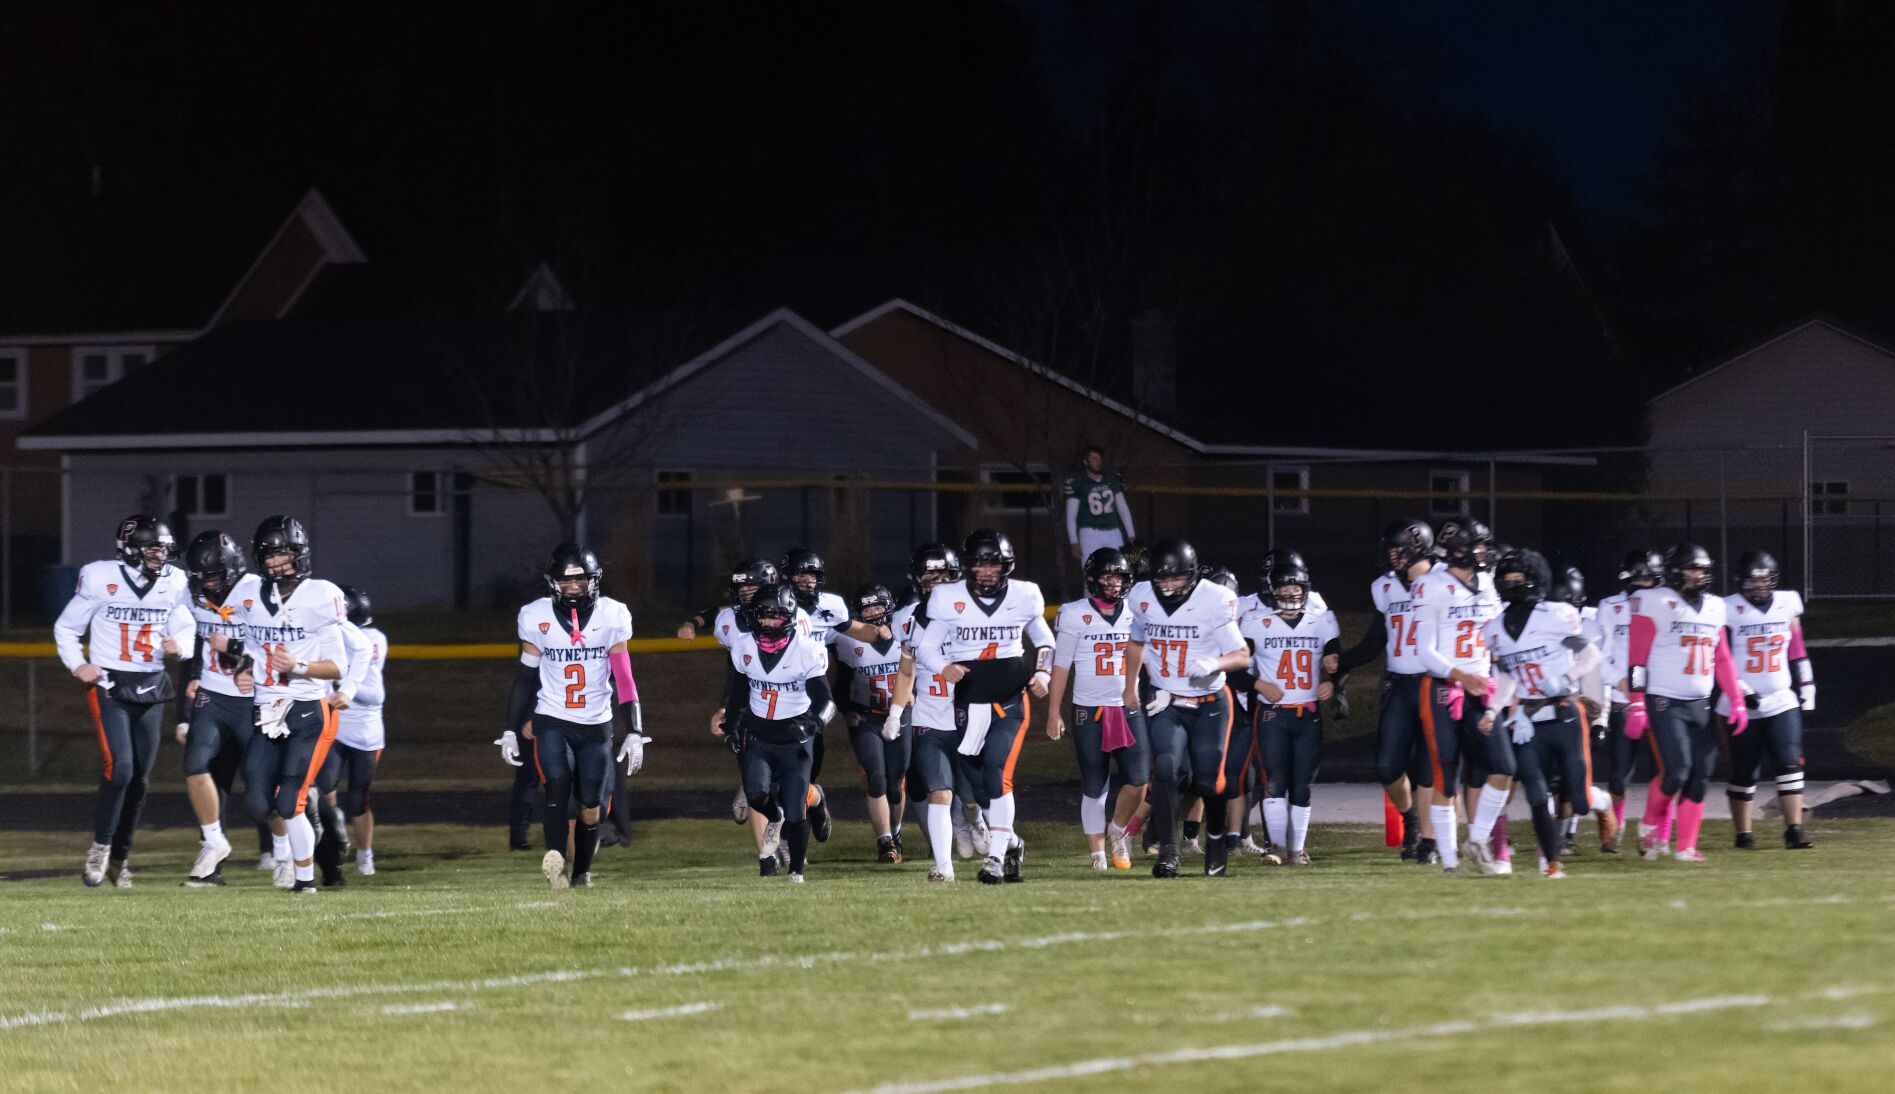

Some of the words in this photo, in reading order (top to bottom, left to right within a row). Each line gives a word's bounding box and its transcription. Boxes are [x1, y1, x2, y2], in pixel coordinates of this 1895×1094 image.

[1088, 490, 1113, 515] 62
[121, 520, 137, 543] P
[106, 606, 167, 622] POYNETTE
[118, 622, 153, 662] 14
[957, 625, 1021, 641] POYNETTE
[1146, 623, 1200, 639] POYNETTE
[1264, 637, 1320, 649] POYNETTE
[1391, 614, 1419, 656] 74
[544, 646, 609, 662] POYNETTE
[1151, 639, 1188, 678] 77
[1746, 634, 1785, 673] 52
[858, 662, 900, 676] POYNET
[1276, 650, 1313, 690] 49
[564, 663, 587, 708] 2
[761, 690, 778, 721] 7
[1075, 710, 1088, 726] P
